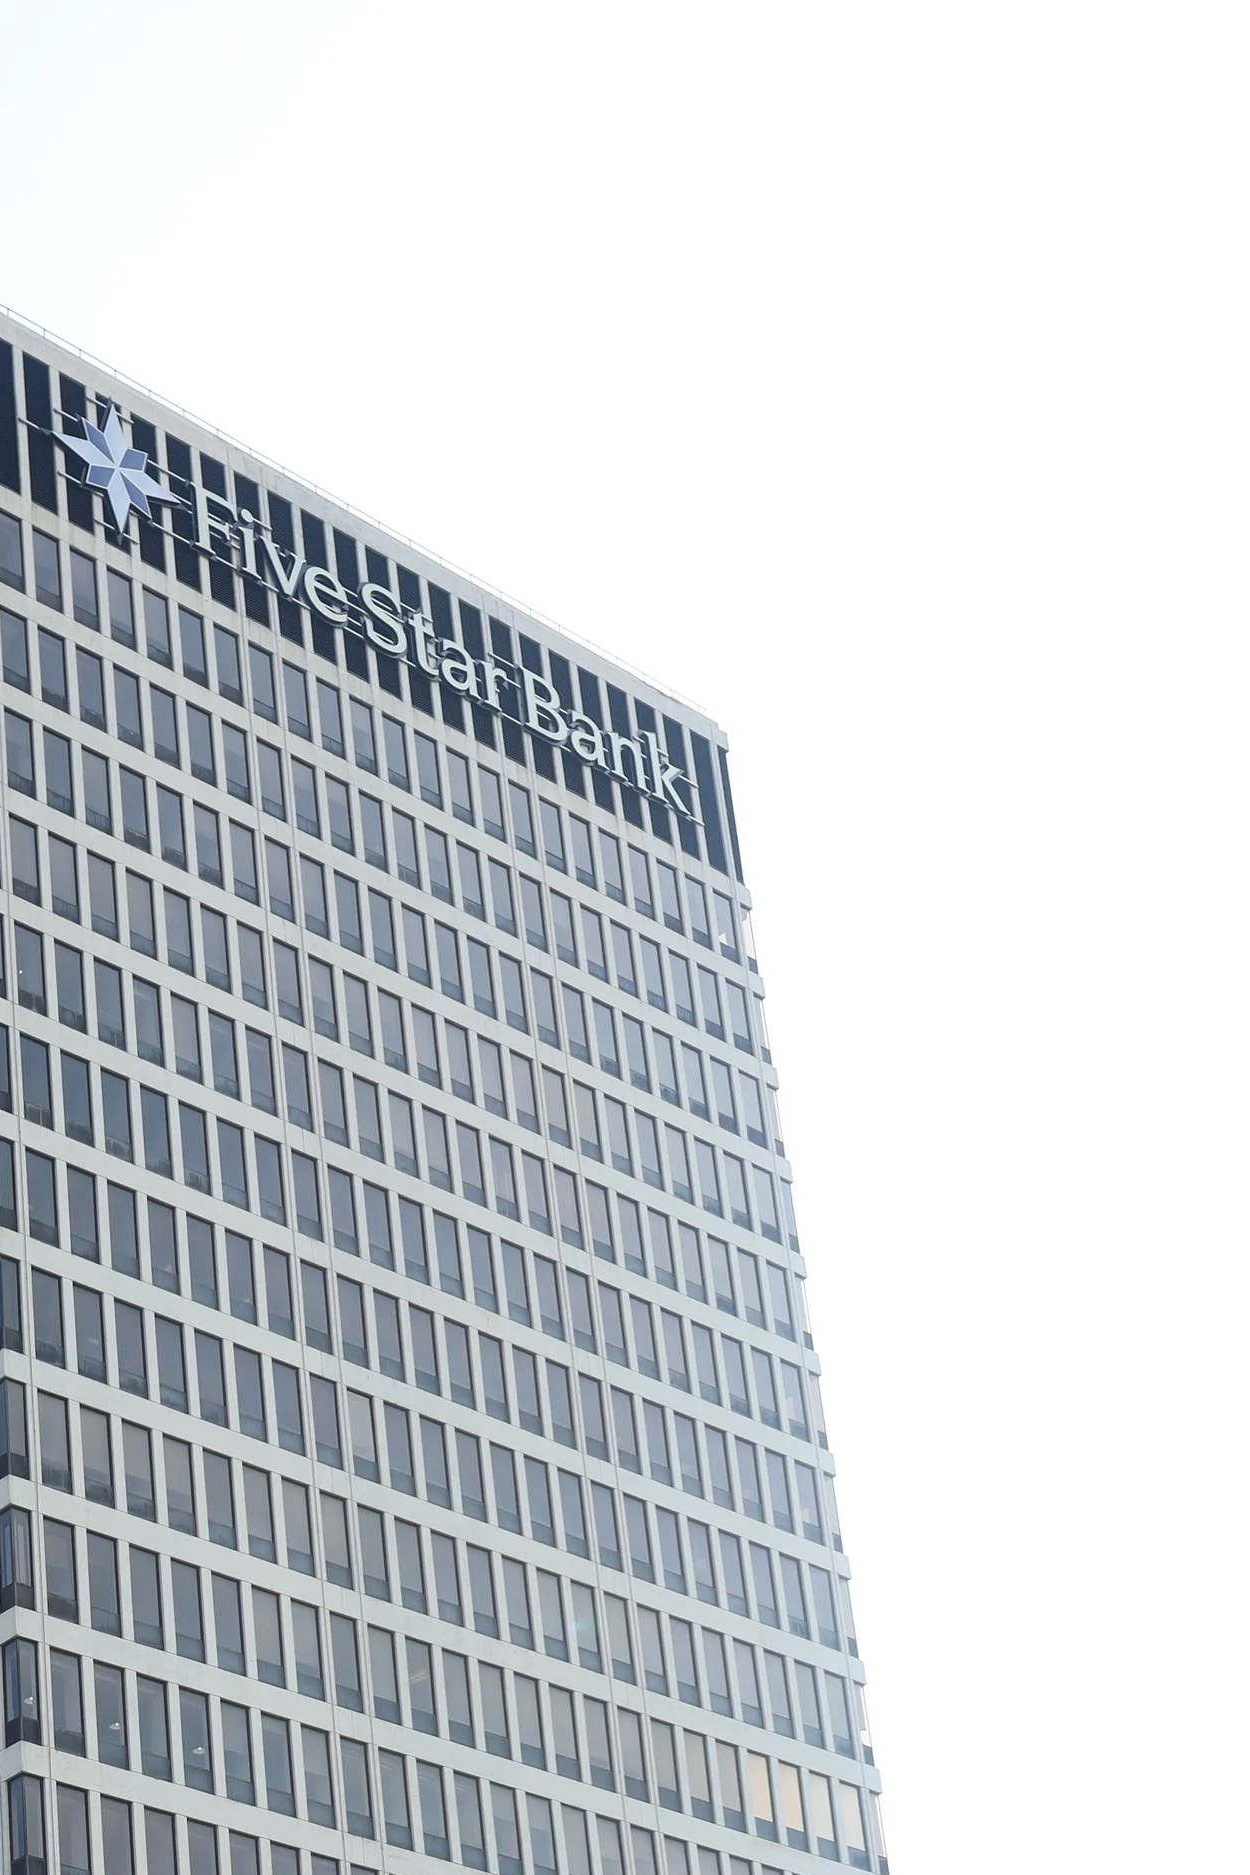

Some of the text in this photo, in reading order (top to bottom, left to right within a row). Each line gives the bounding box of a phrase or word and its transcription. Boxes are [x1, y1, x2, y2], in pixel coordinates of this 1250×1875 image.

[191, 482, 691, 816] Five Star Bank
